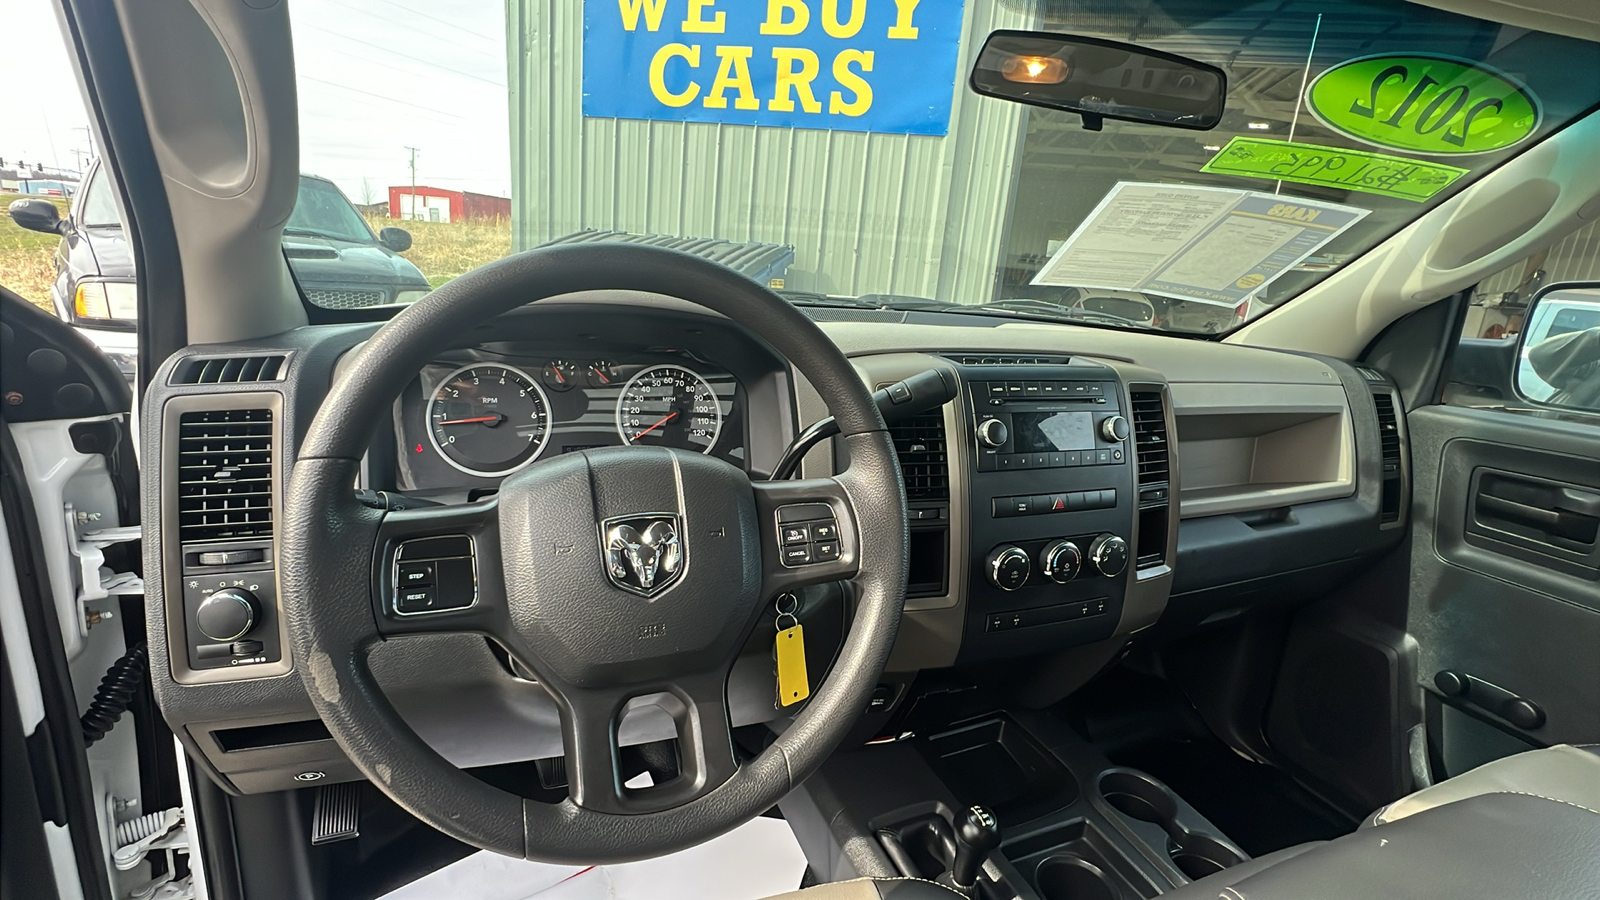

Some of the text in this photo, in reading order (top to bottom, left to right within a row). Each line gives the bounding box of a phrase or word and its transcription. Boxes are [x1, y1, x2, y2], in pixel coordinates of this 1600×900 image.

[759, 0, 924, 40] BUY
[648, 43, 875, 117] CARS
[531, 411, 538, 419] 6
[448, 435, 455, 443] 0
